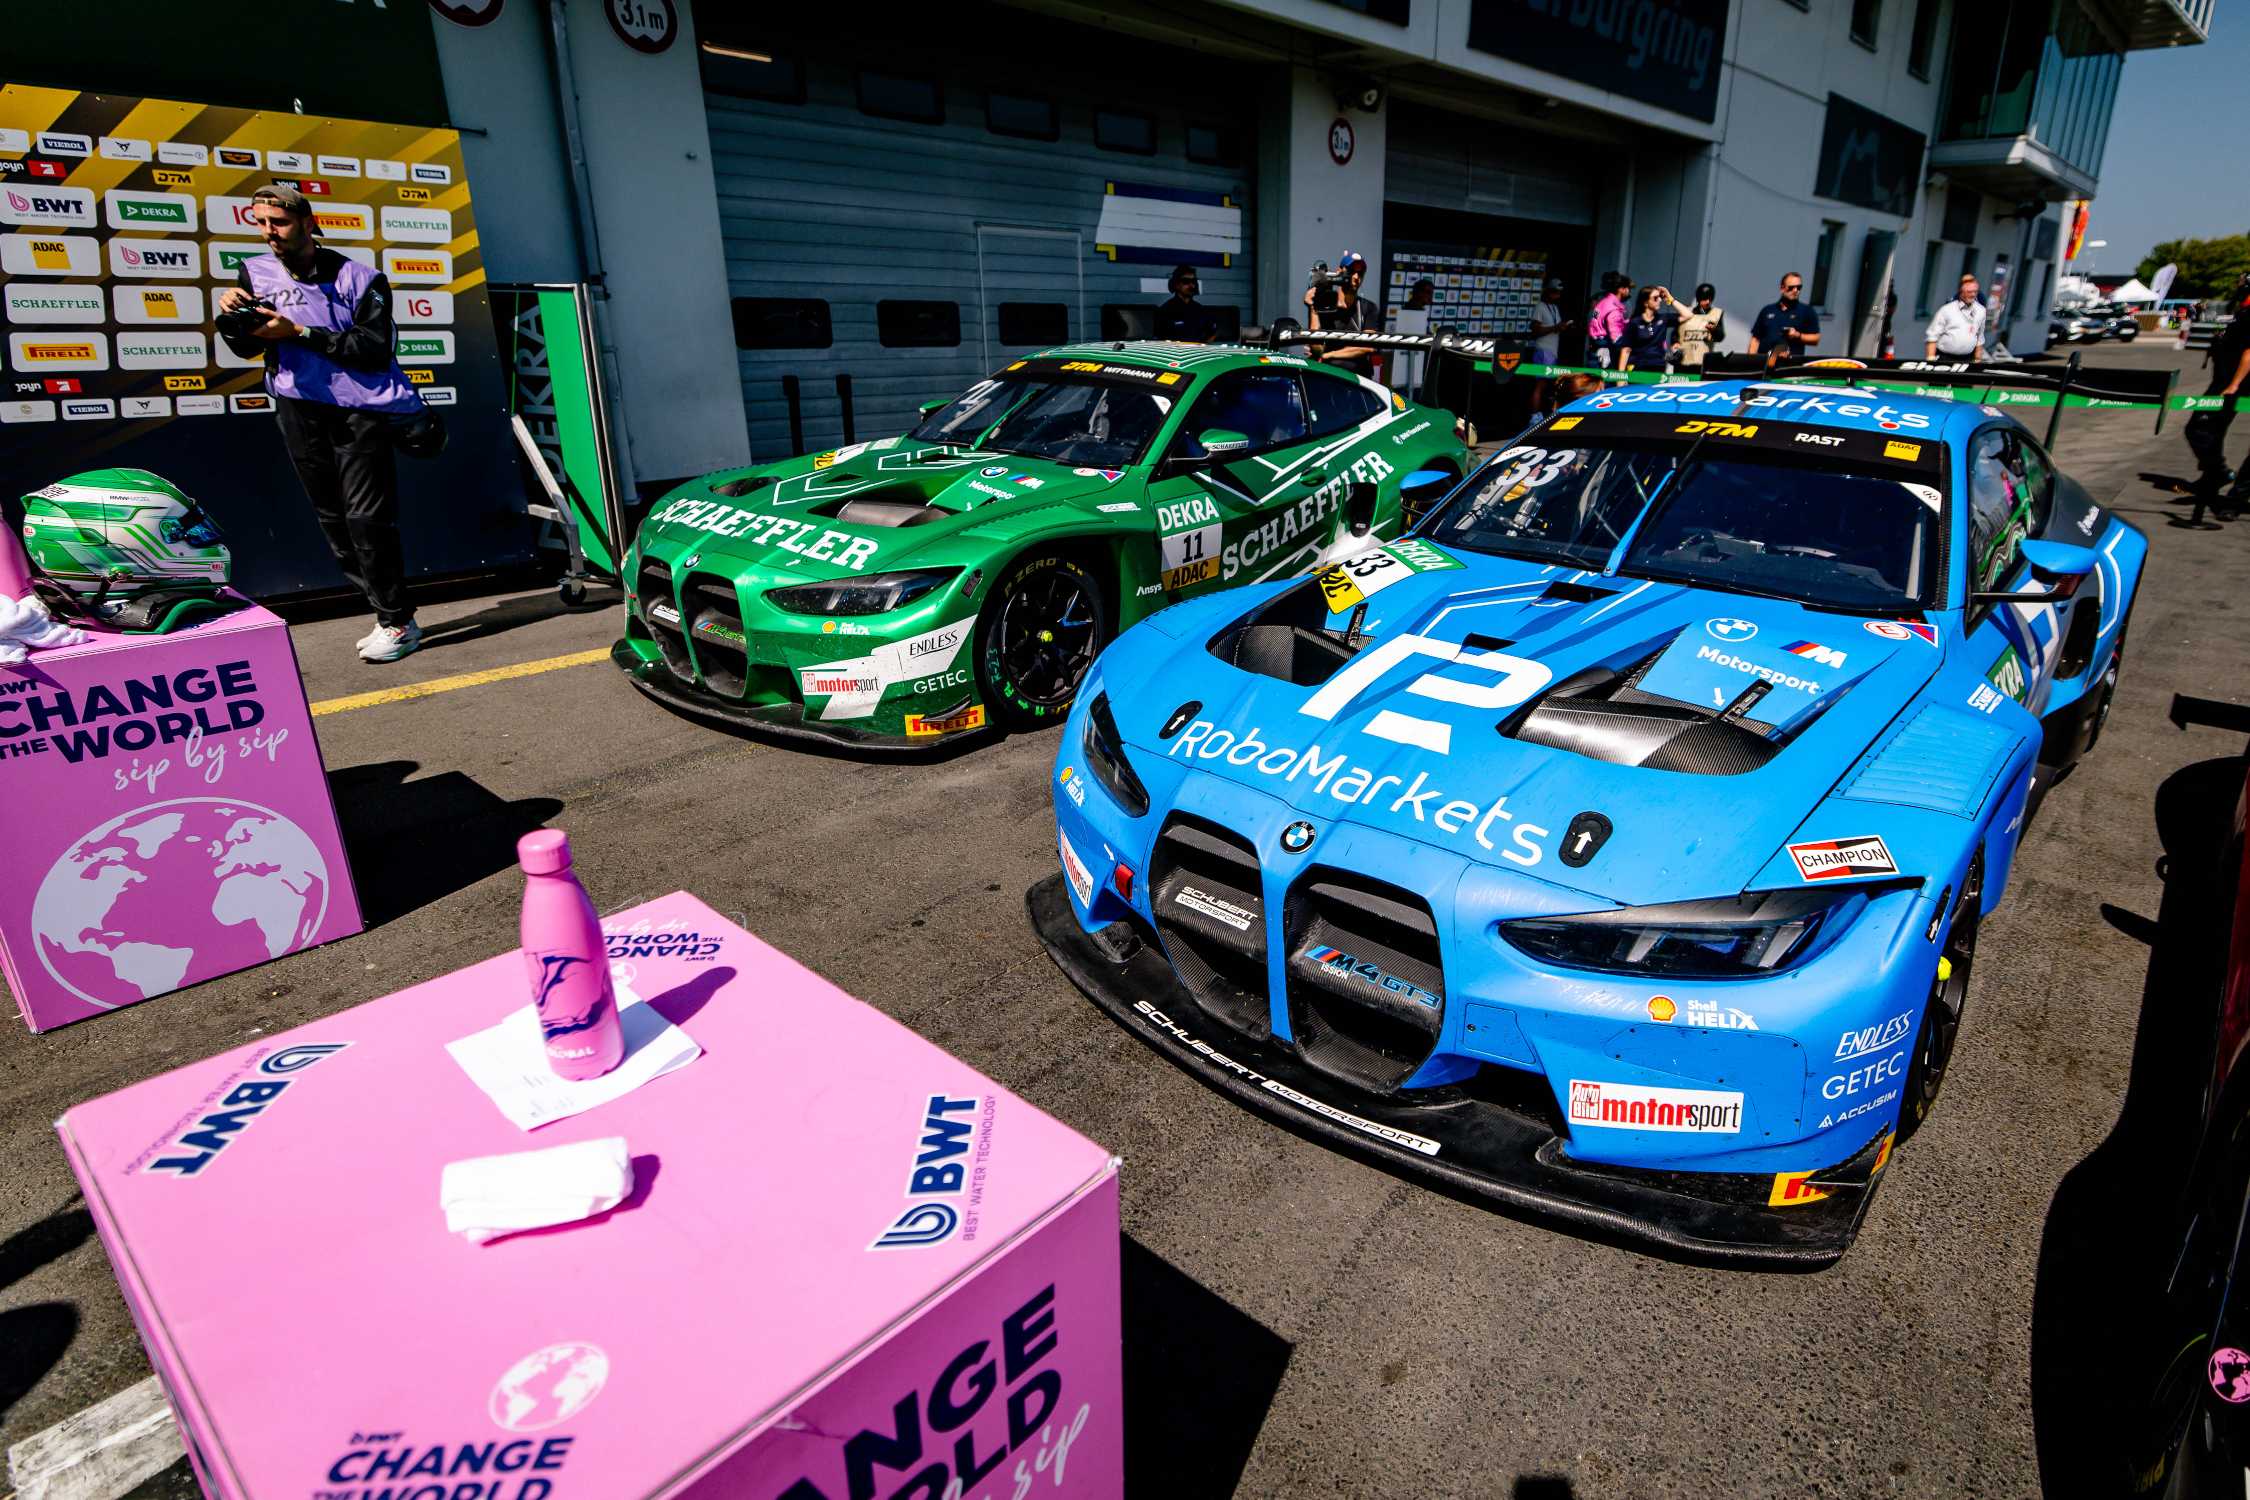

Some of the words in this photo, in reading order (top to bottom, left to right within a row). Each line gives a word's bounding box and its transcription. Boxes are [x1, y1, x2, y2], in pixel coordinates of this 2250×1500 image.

[620, 0, 647, 27] 3.1
[649, 12, 665, 30] m
[1527, 0, 1714, 90] burgring
[157, 172, 192, 184] DTM
[32, 197, 84, 214] BWT
[401, 190, 429, 200] DTM
[141, 207, 178, 217] DEKRA
[385, 219, 449, 231] SCHAEFFLER
[33, 242, 64, 252] ADAC
[143, 251, 189, 266] BWT
[396, 260, 441, 273] PIRELLI
[12, 299, 100, 309] SCHAEFFLER
[144, 292, 174, 302] ADAC
[408, 299, 433, 317] IG
[28, 346, 91, 358] PIRELLI
[123, 346, 202, 355] SCHAEFFLER
[411, 344, 440, 352] DEKRA
[1060, 361, 1105, 373] DTM
[1103, 366, 1156, 380] WITTMANN
[1900, 361, 1970, 373] Shell
[169, 379, 202, 388] DTM
[71, 405, 106, 414] VIEROL
[1674, 420, 1759, 438] DTM
[1794, 432, 1846, 446] RAST
[1157, 496, 1220, 531] DEKRA
[1223, 451, 1394, 581] SCHAEFFLER
[651, 499, 879, 571] SCHAEFFLER
[1182, 531, 1204, 564] 11
[1390, 539, 1455, 571] DEKRA
[1171, 561, 1209, 589] ADAC
[1341, 553, 1396, 577] 33
[1136, 581, 1162, 597] Ansys
[909, 631, 959, 656] ENDLESS
[913, 669, 968, 694] GETEC
[1697, 646, 1820, 696] Motorsport
[816, 676, 880, 693] motorsport
[0, 660, 257, 739] CHANGE
[0, 738, 49, 760] THE
[51, 700, 265, 764] WORLD
[114, 757, 170, 794] sip
[184, 726, 227, 784] by
[239, 727, 289, 761] sip
[1169, 720, 1551, 868] RoboMarkets
[1801, 847, 1885, 869] CHAMPION
[1178, 895, 1247, 927] MOTORSPORT
[1181, 886, 1258, 921] SCHUBERT
[607, 943, 721, 959] CHANG
[1329, 952, 1383, 985] M4
[1381, 975, 1442, 1010] GT3
[1687, 1000, 1717, 1012] Shell
[1687, 1007, 1760, 1031] HELIX
[1835, 1010, 1913, 1058] ENDLESS
[1133, 1000, 1270, 1083] SCHUBERT
[1271, 1084, 1432, 1149] MOTORSPORT
[1822, 1052, 1904, 1099] GETEC
[1573, 1083, 1600, 1101] Auto
[1573, 1102, 1599, 1119] Bild
[1602, 1097, 1741, 1131] motorsport
[1837, 1090, 1897, 1121] ACCUSIM
[148, 1081, 292, 1176] BWT
[976, 1095, 996, 1165] TECHNOLOGY
[909, 1095, 977, 1194] BWT
[970, 1167, 987, 1206] WATER
[963, 1209, 979, 1241] BEST
[326, 1436, 575, 1483] CHANGE
